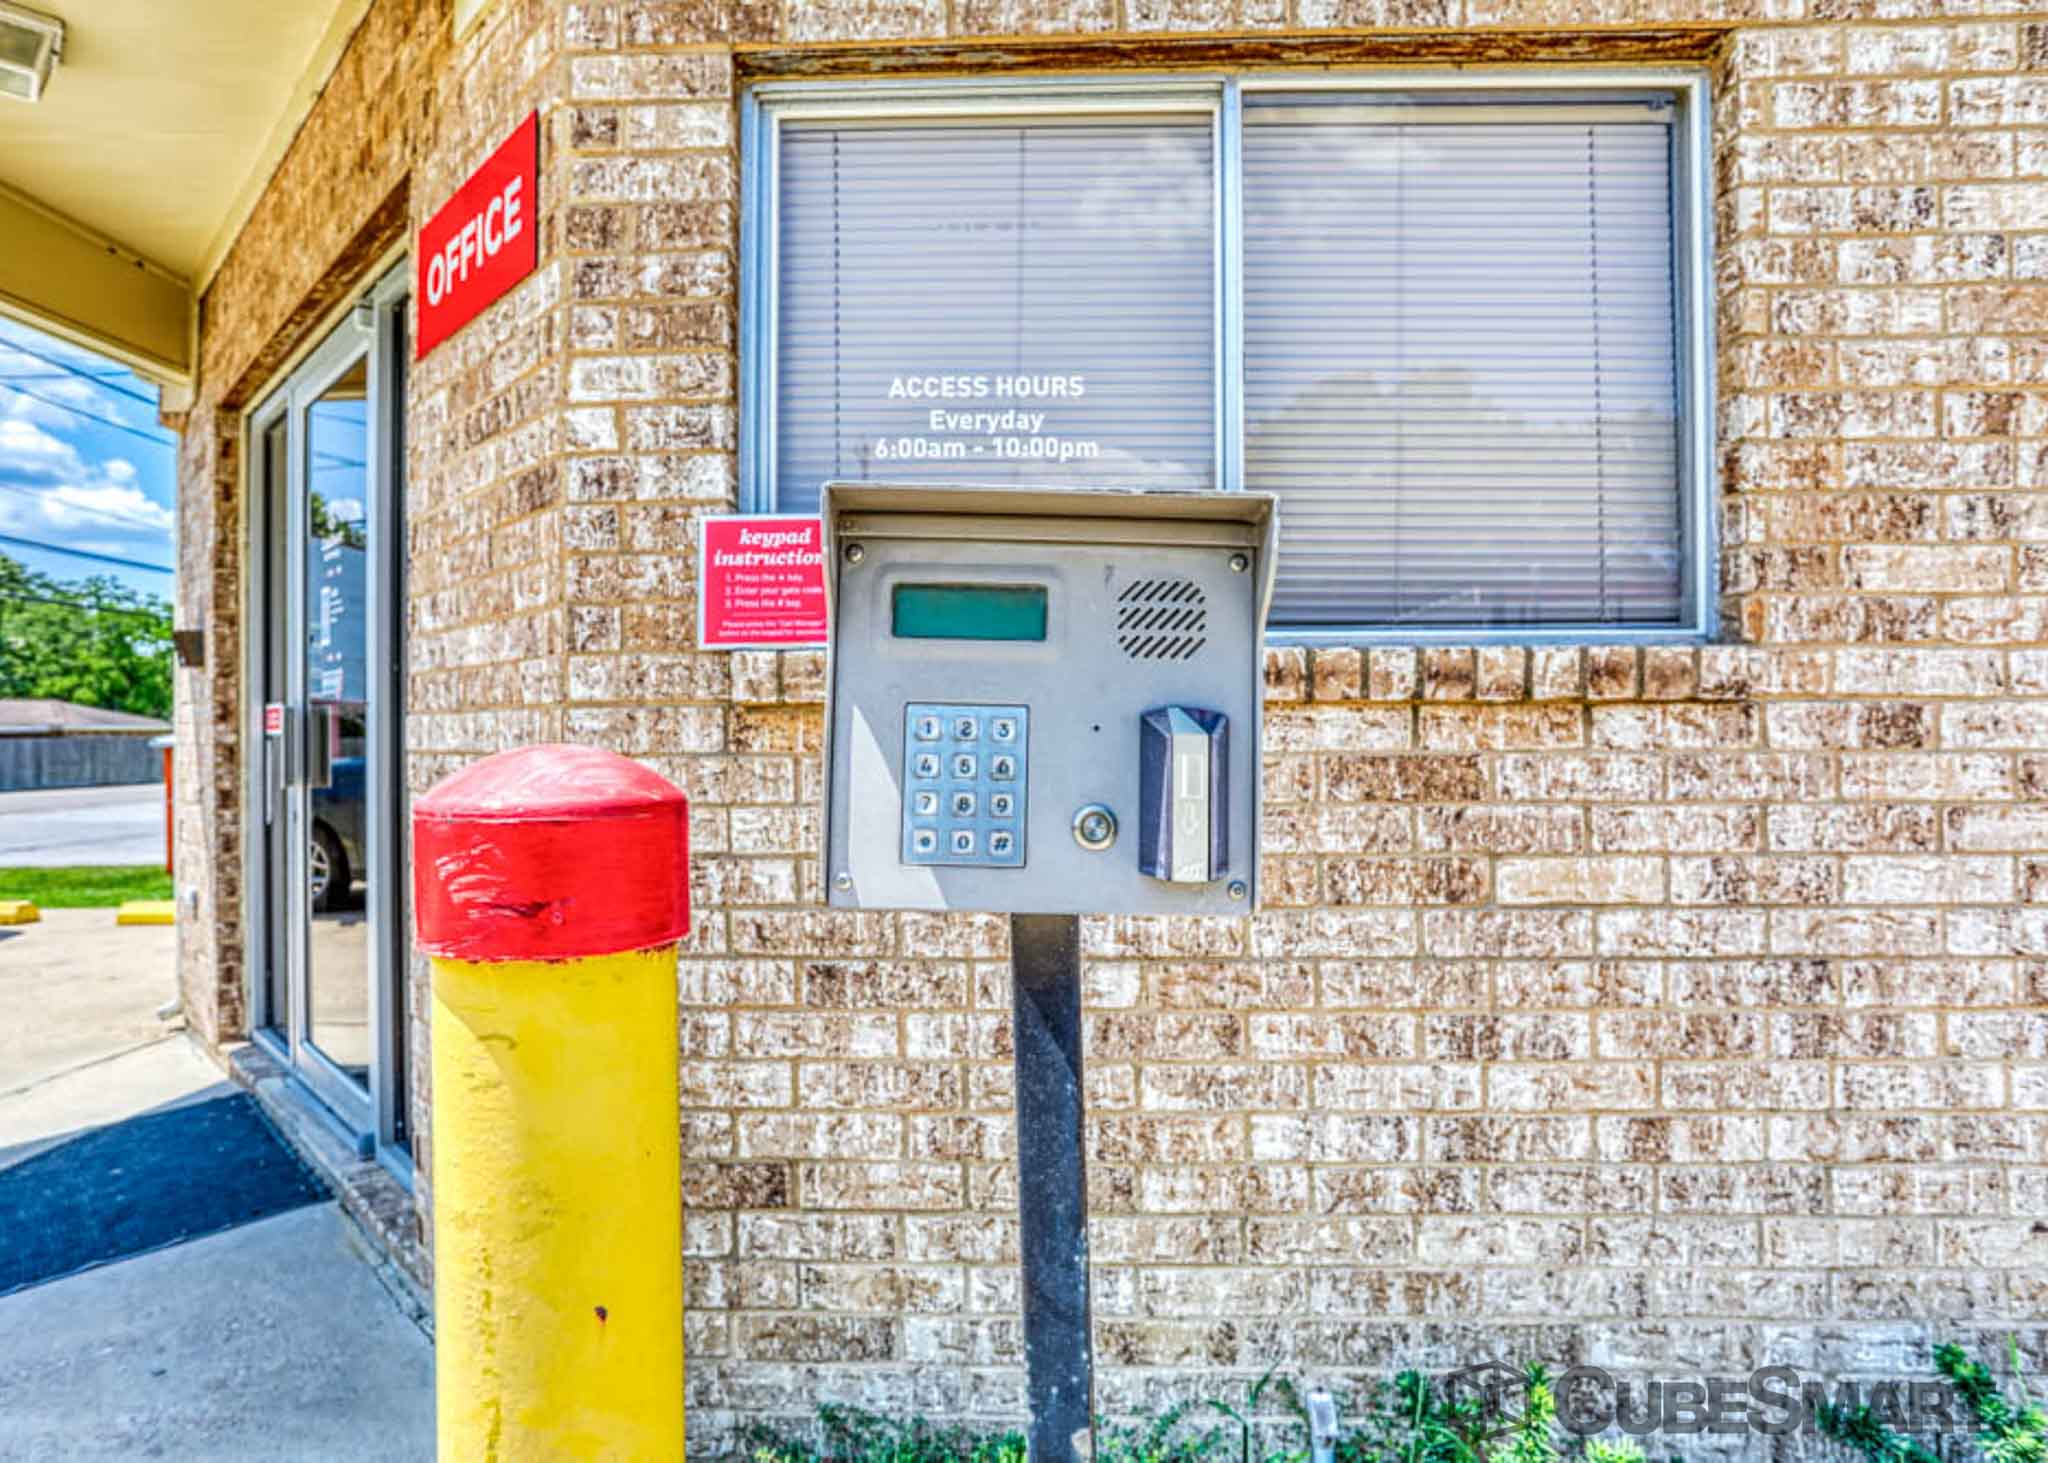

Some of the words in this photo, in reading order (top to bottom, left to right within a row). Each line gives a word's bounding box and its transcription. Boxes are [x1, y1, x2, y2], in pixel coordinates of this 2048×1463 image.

[427, 175, 523, 306] OFFICE
[889, 376, 988, 398] ACCESS
[996, 376, 1085, 398] HOURS
[929, 409, 1045, 434] Everyday
[874, 438, 966, 460] 6:00am
[992, 437, 1098, 462] 10:00pm
[739, 528, 812, 548] keypad
[924, 721, 933, 735] 1
[960, 720, 973, 737] 2
[997, 720, 1010, 738] 3
[920, 757, 933, 773] 4
[959, 758, 971, 775] 5
[996, 758, 1010, 775] 6
[920, 795, 932, 810] 7
[956, 795, 970, 812] 8
[996, 796, 1008, 812] 9
[957, 835, 970, 851] 0
